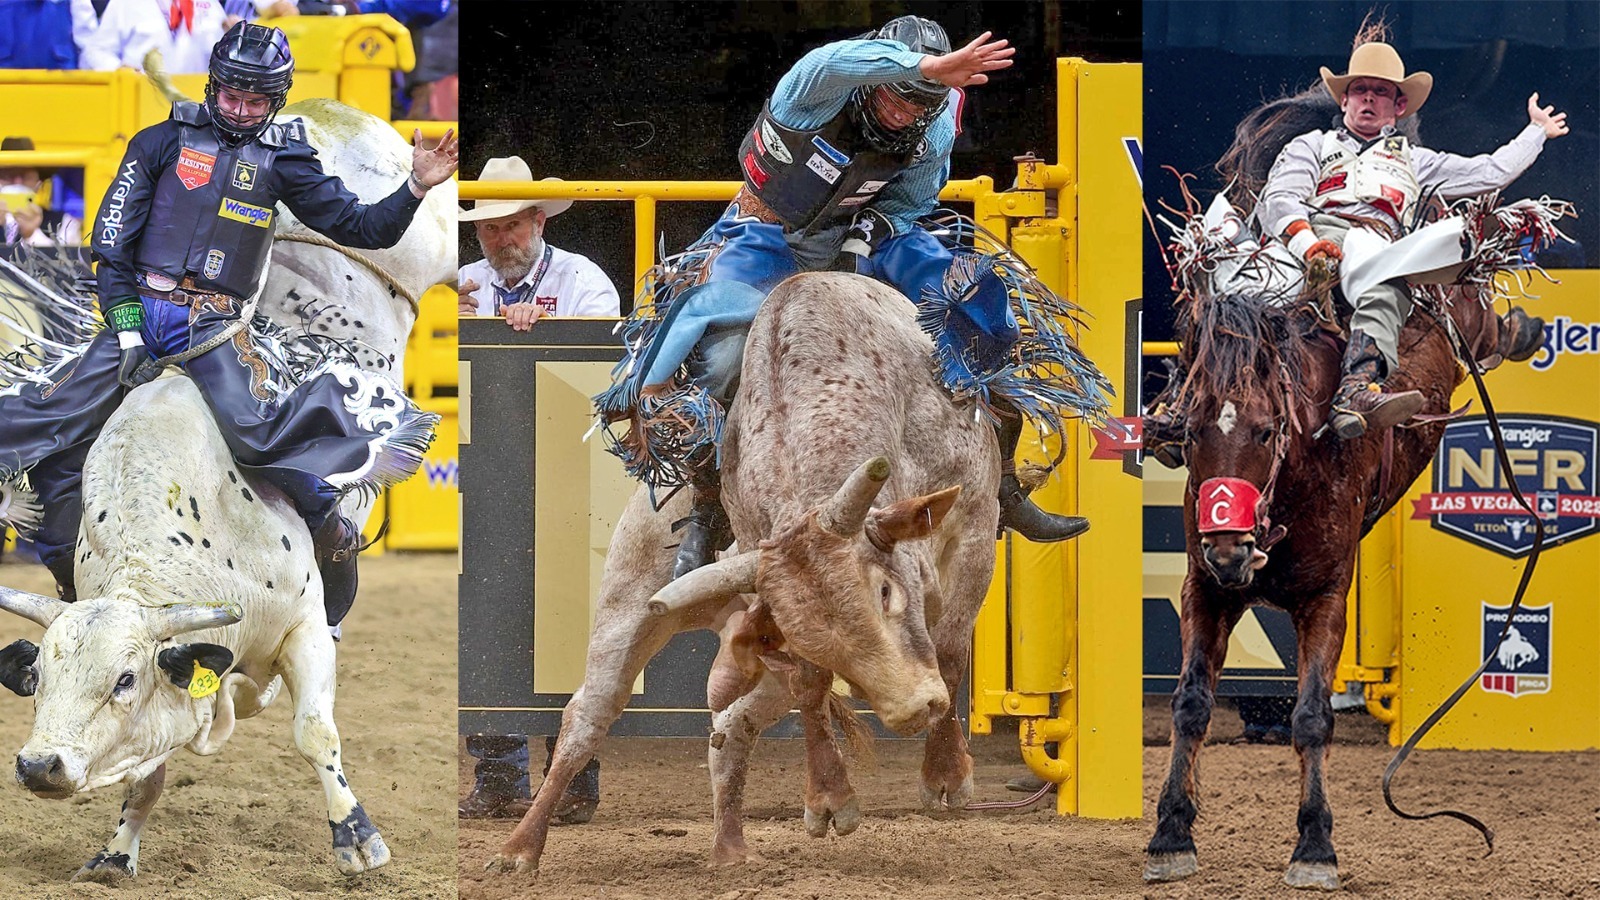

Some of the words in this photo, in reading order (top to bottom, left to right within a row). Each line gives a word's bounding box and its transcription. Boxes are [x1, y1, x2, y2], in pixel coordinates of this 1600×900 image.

[179, 156, 213, 173] RESISTOL
[101, 160, 138, 247] Wrangler
[224, 199, 271, 224] Wrangler
[1531, 316, 1600, 370] gler
[1448, 447, 1586, 491] NFR
[1430, 497, 1466, 511] LAS
[1474, 523, 1508, 533] TETON
[1525, 524, 1558, 534] RIGE
[1486, 613, 1548, 623] PROODEO
